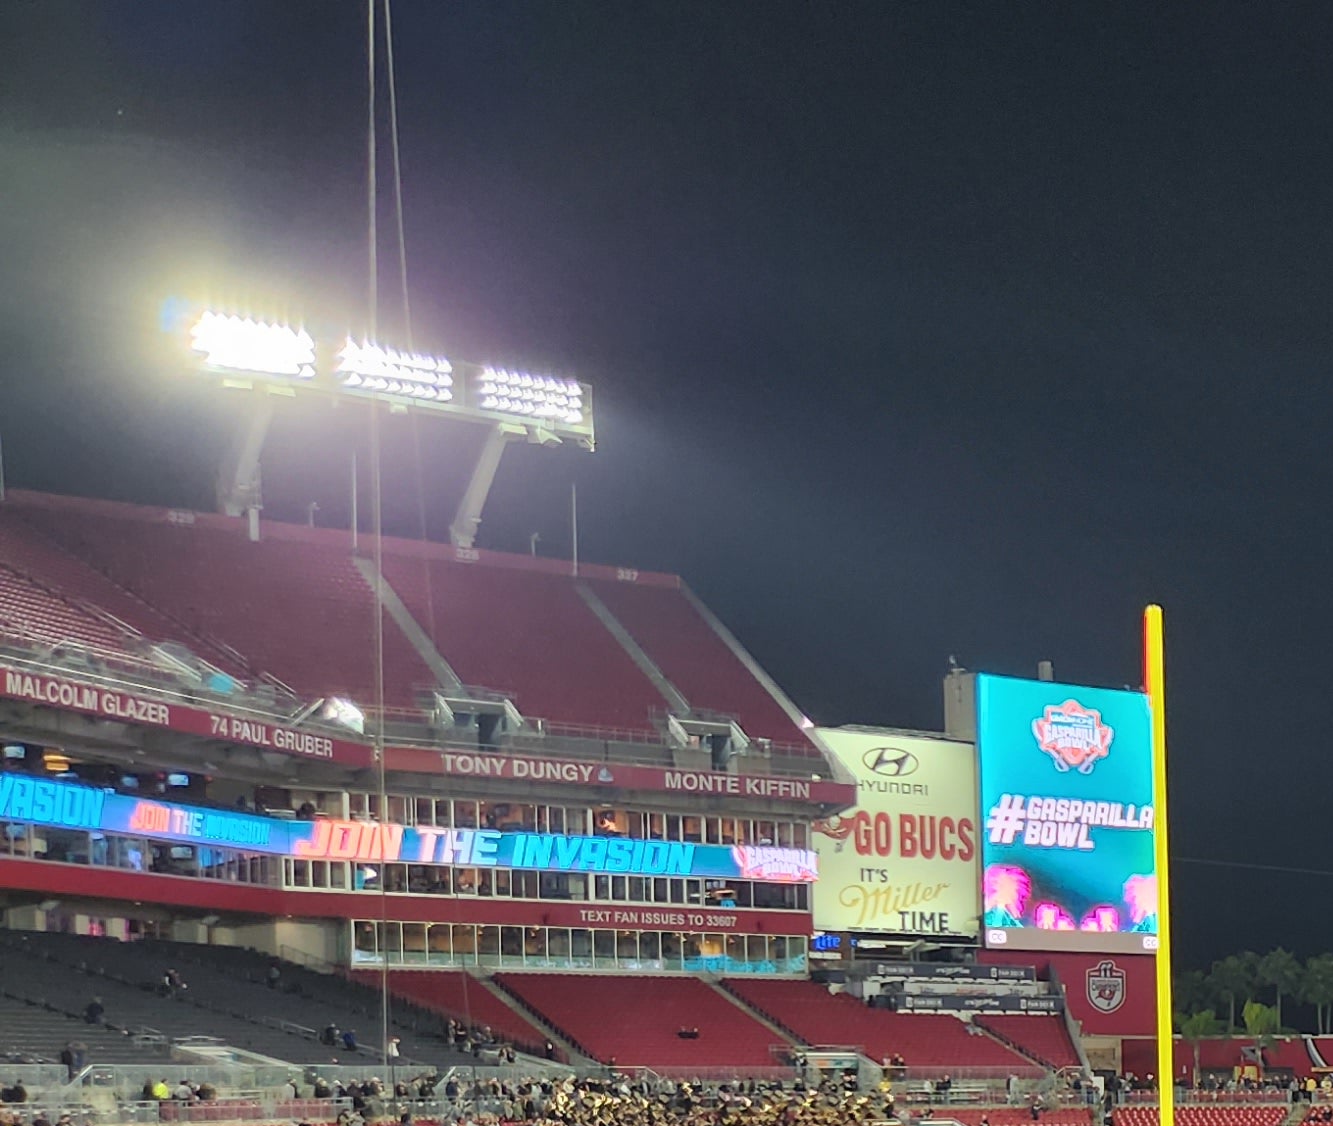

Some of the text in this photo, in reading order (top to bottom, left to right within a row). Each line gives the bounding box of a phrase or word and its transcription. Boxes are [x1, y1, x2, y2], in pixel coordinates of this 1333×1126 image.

[6, 671, 170, 725] MALCOLM GLAZER
[209, 714, 333, 758] 74 PAUL GRUBER
[441, 753, 594, 782] TONY DUNGY
[664, 771, 811, 799] MONTE KIFFIN
[130, 802, 171, 832] JOIN
[172, 809, 203, 837] THE
[293, 818, 696, 875] JOIN THE INVASION
[854, 810, 975, 862] GO BUCS
[1024, 822, 1095, 850] BOWL
[860, 868, 888, 883] IT'S
[580, 909, 737, 928] TEXT FAN ISSUES TO 33607
[839, 882, 952, 925] Miller
[898, 911, 949, 933] TIME
